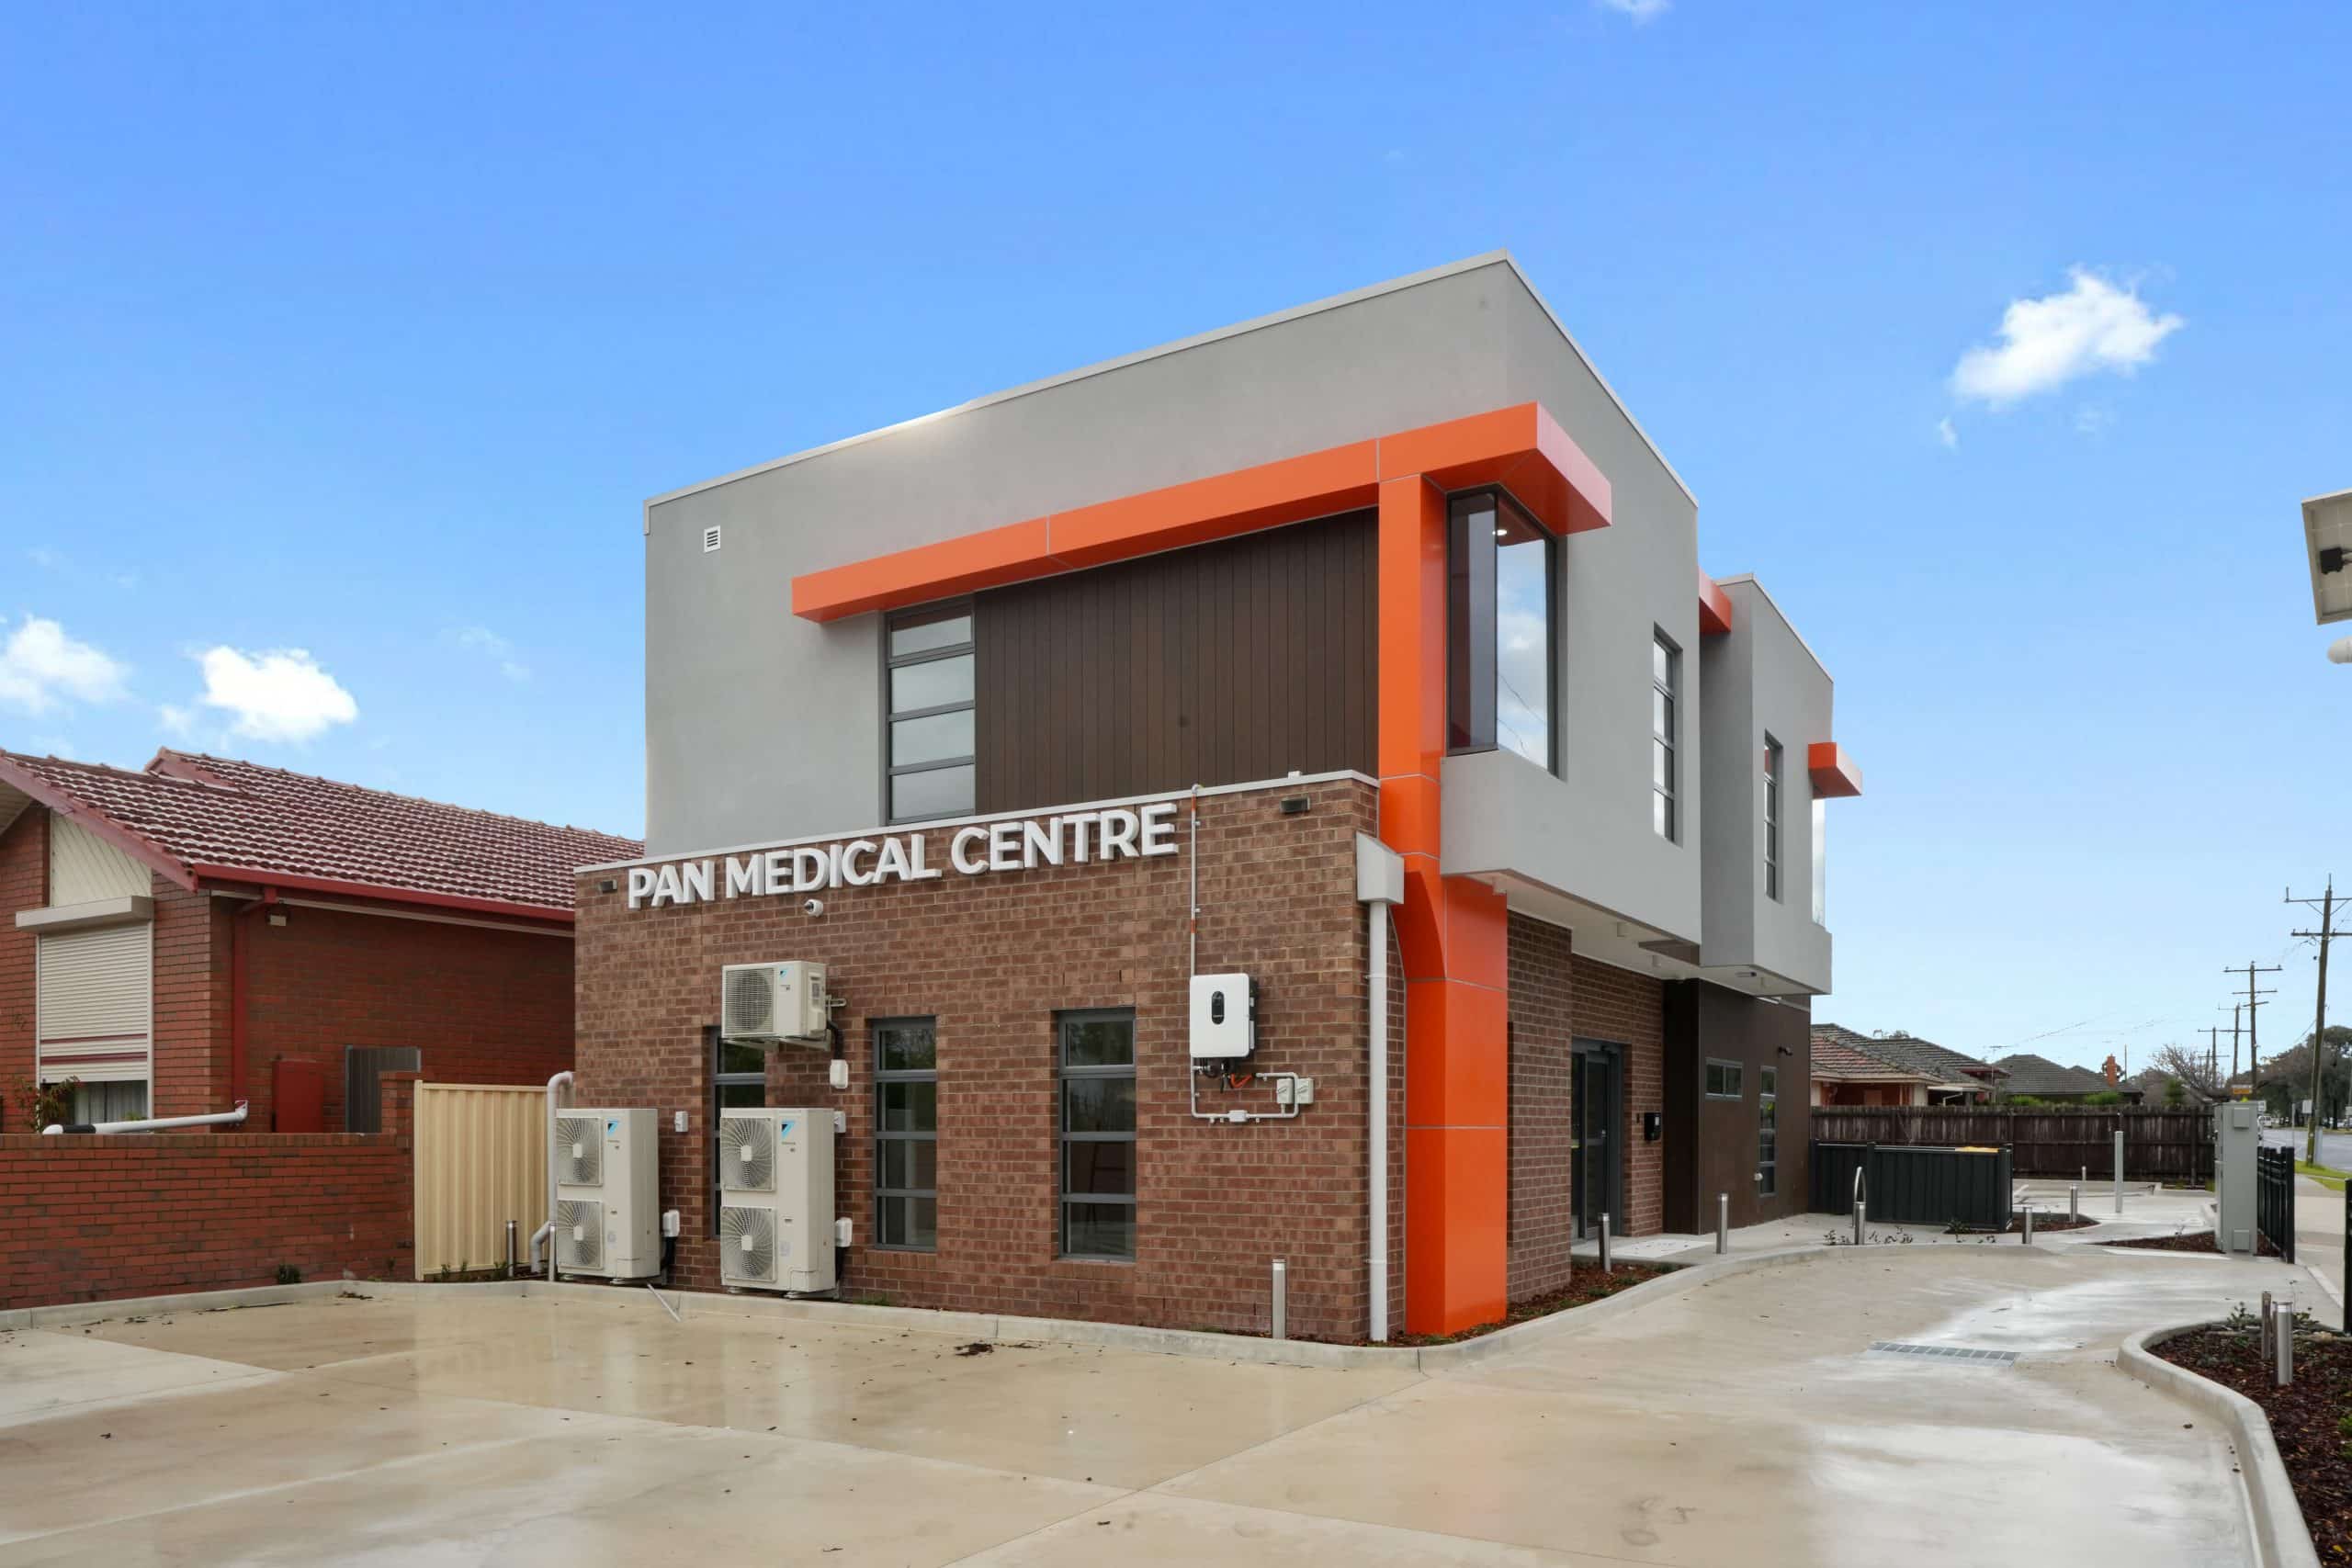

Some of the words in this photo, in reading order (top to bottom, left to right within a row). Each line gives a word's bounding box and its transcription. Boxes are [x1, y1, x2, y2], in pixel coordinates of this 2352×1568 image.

[628, 859, 716, 908] PAN
[726, 834, 942, 898] MEDICAL
[951, 803, 1179, 874] CENTRE
